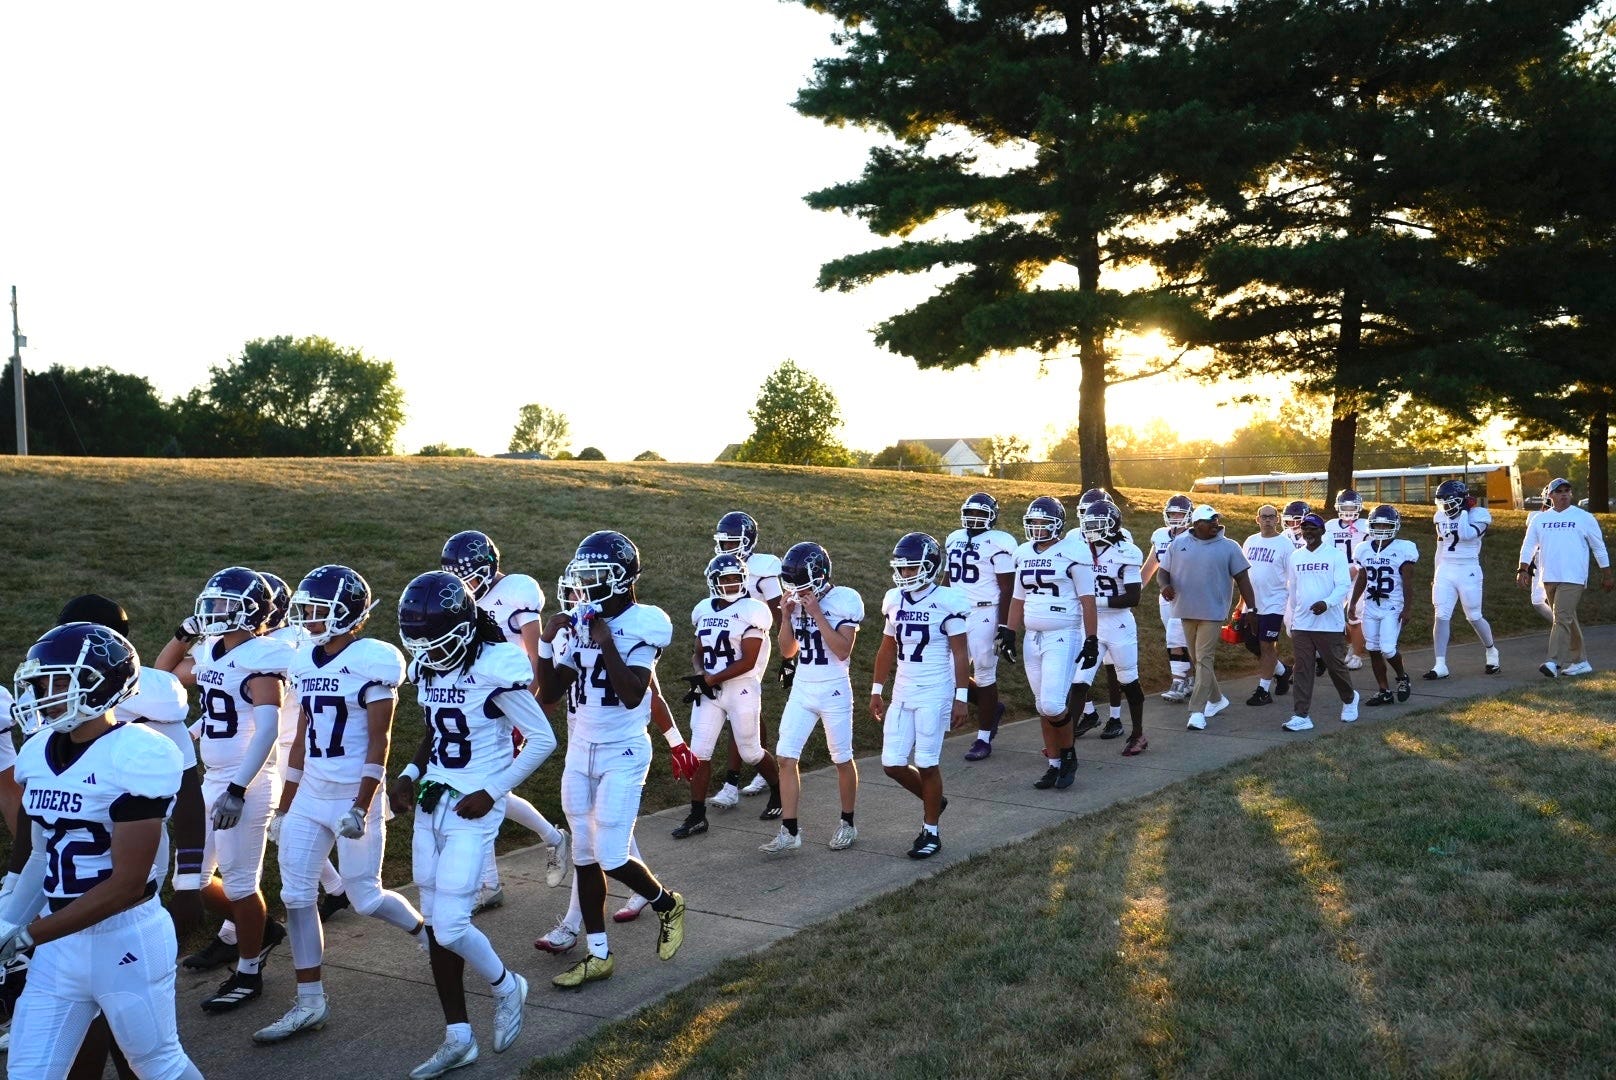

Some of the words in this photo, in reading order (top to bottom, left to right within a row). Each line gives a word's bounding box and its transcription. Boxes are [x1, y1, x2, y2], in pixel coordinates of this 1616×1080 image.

[1541, 521, 1576, 529] TIGER
[1334, 539, 1354, 563] 1
[949, 549, 980, 584] 66
[1023, 558, 1053, 568] TIGERS
[1296, 562, 1330, 572] TIGER
[702, 617, 730, 628] TIGERS
[698, 628, 736, 670] 54
[896, 623, 931, 663] 17
[301, 677, 340, 693] TIGERS
[571, 651, 620, 707] 14
[426, 687, 466, 704] TIGERS
[29, 789, 83, 813] TIGERS
